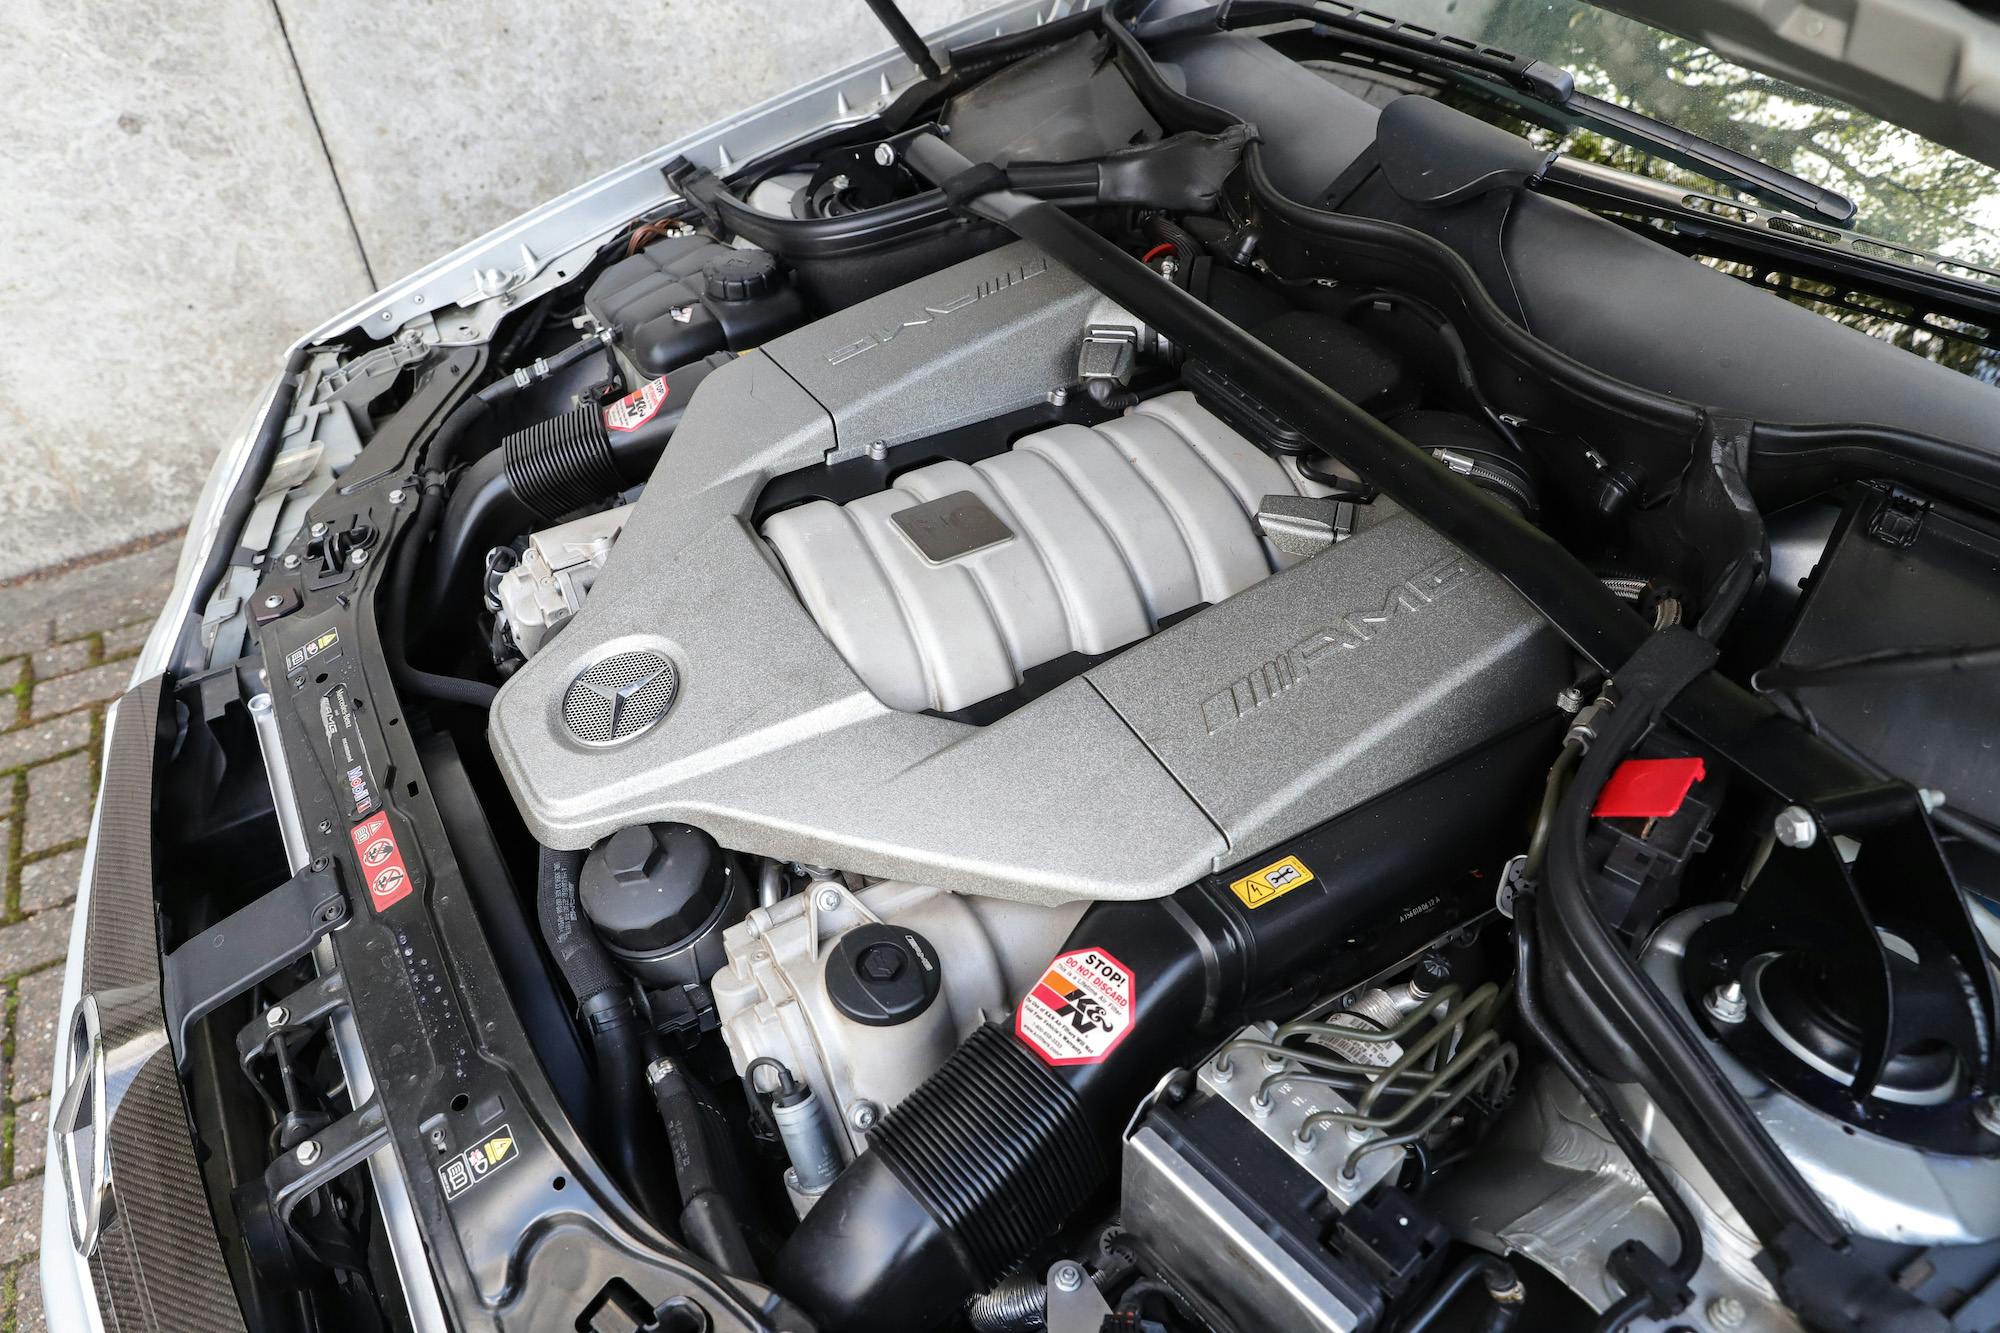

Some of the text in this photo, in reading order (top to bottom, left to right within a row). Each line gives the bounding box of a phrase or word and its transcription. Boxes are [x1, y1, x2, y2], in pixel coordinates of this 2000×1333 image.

[336, 688, 352, 729] Mercedes-Benz
[347, 765, 369, 802] Mobil
[1065, 957, 1128, 1007] DO NOT DISCARD
[1086, 954, 1126, 988] STOP!
[1054, 989, 1114, 1035] K&N
